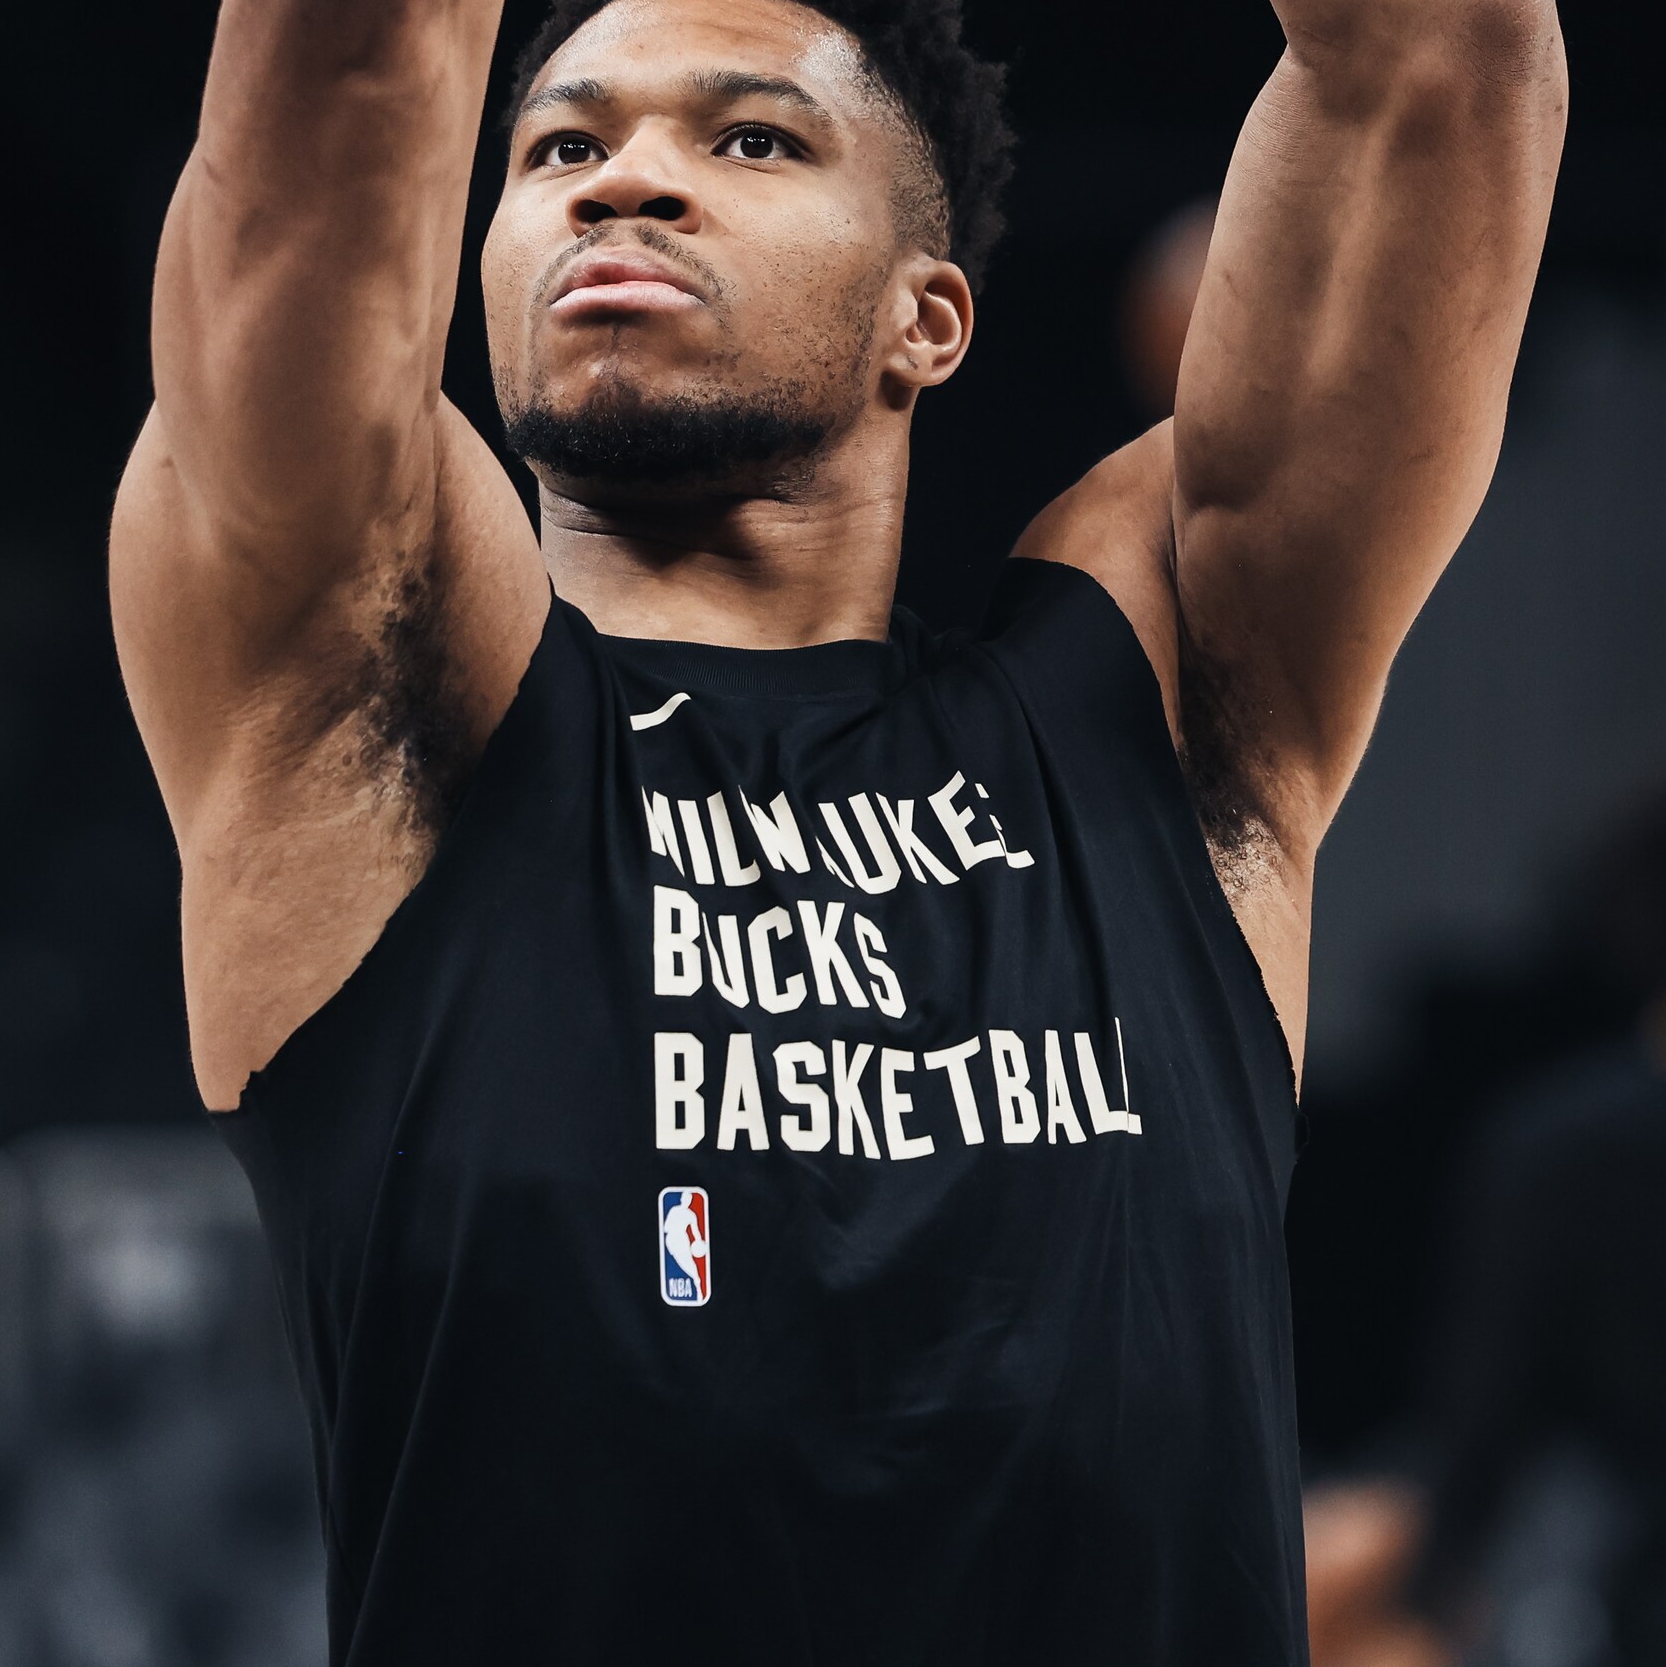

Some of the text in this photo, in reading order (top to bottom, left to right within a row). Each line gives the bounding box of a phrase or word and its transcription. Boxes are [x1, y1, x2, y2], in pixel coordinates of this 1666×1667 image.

[641, 769, 1035, 895] MILWUKE
[653, 884, 907, 1020] BUCKS
[668, 1277, 693, 1298] NBA
